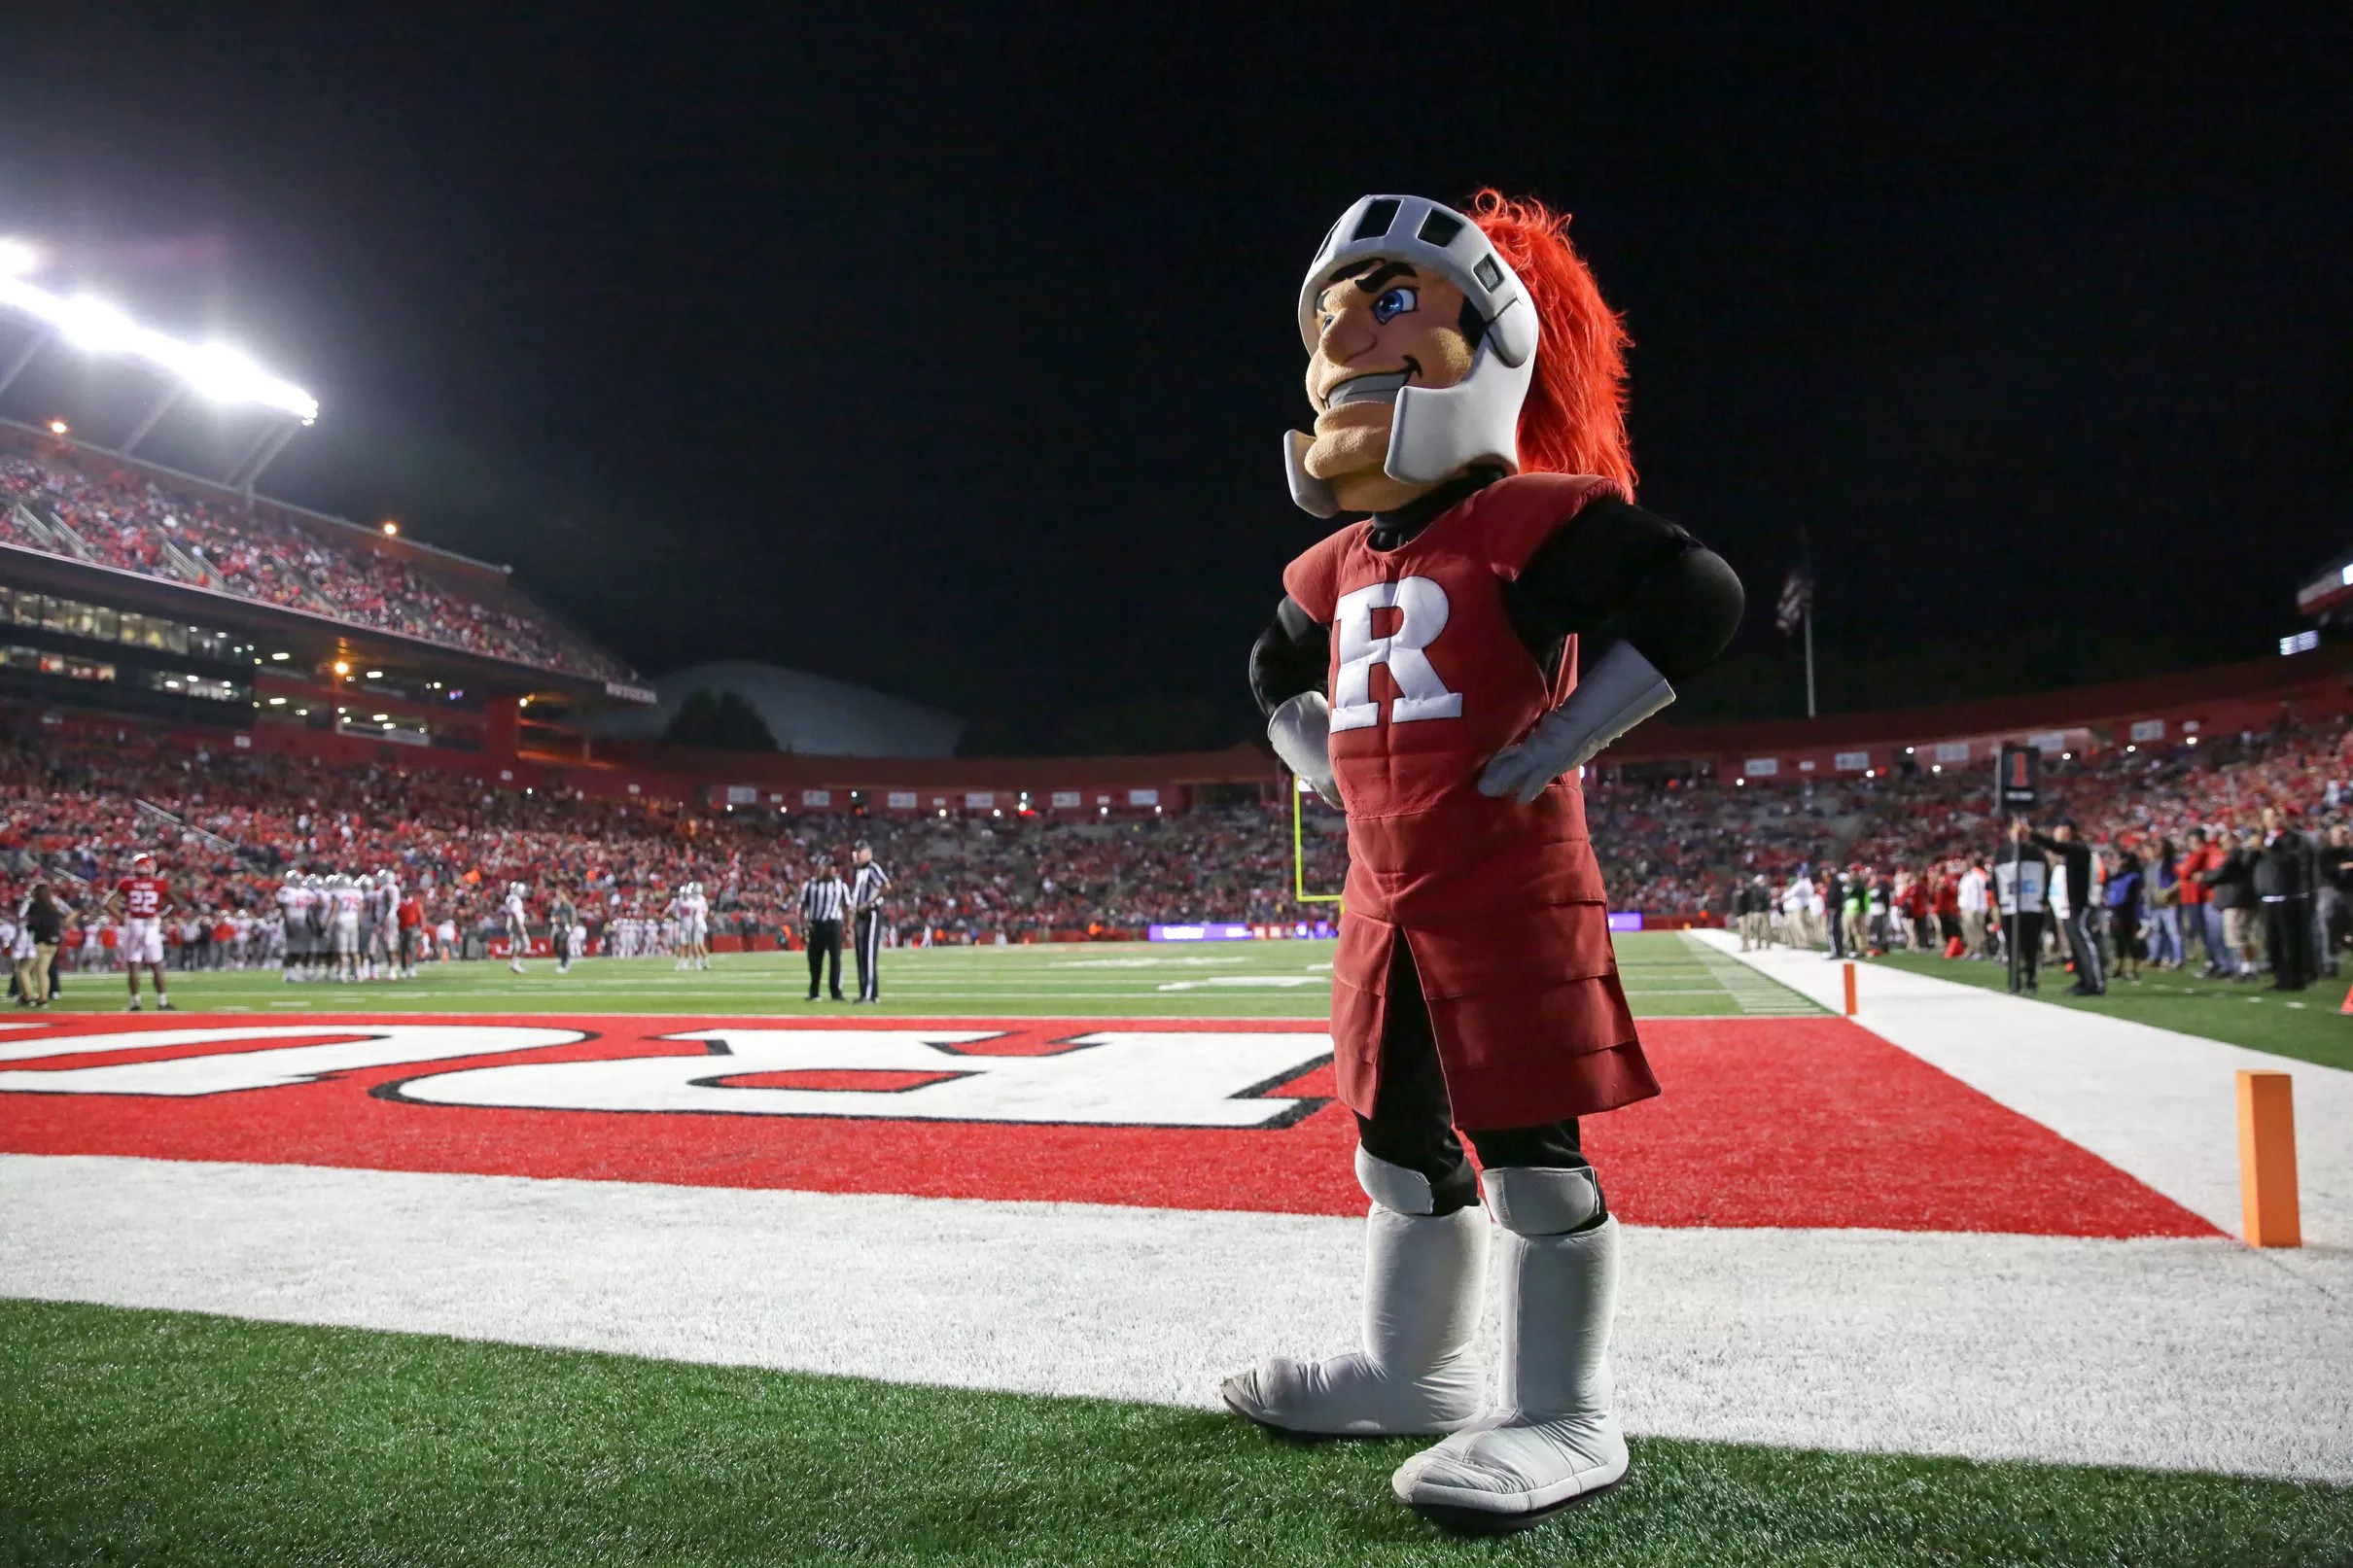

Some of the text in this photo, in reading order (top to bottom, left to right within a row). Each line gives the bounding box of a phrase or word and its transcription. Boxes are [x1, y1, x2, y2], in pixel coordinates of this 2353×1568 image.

[1330, 575, 1462, 735] R
[2011, 752, 2030, 786] 1
[129, 889, 159, 913] 22
